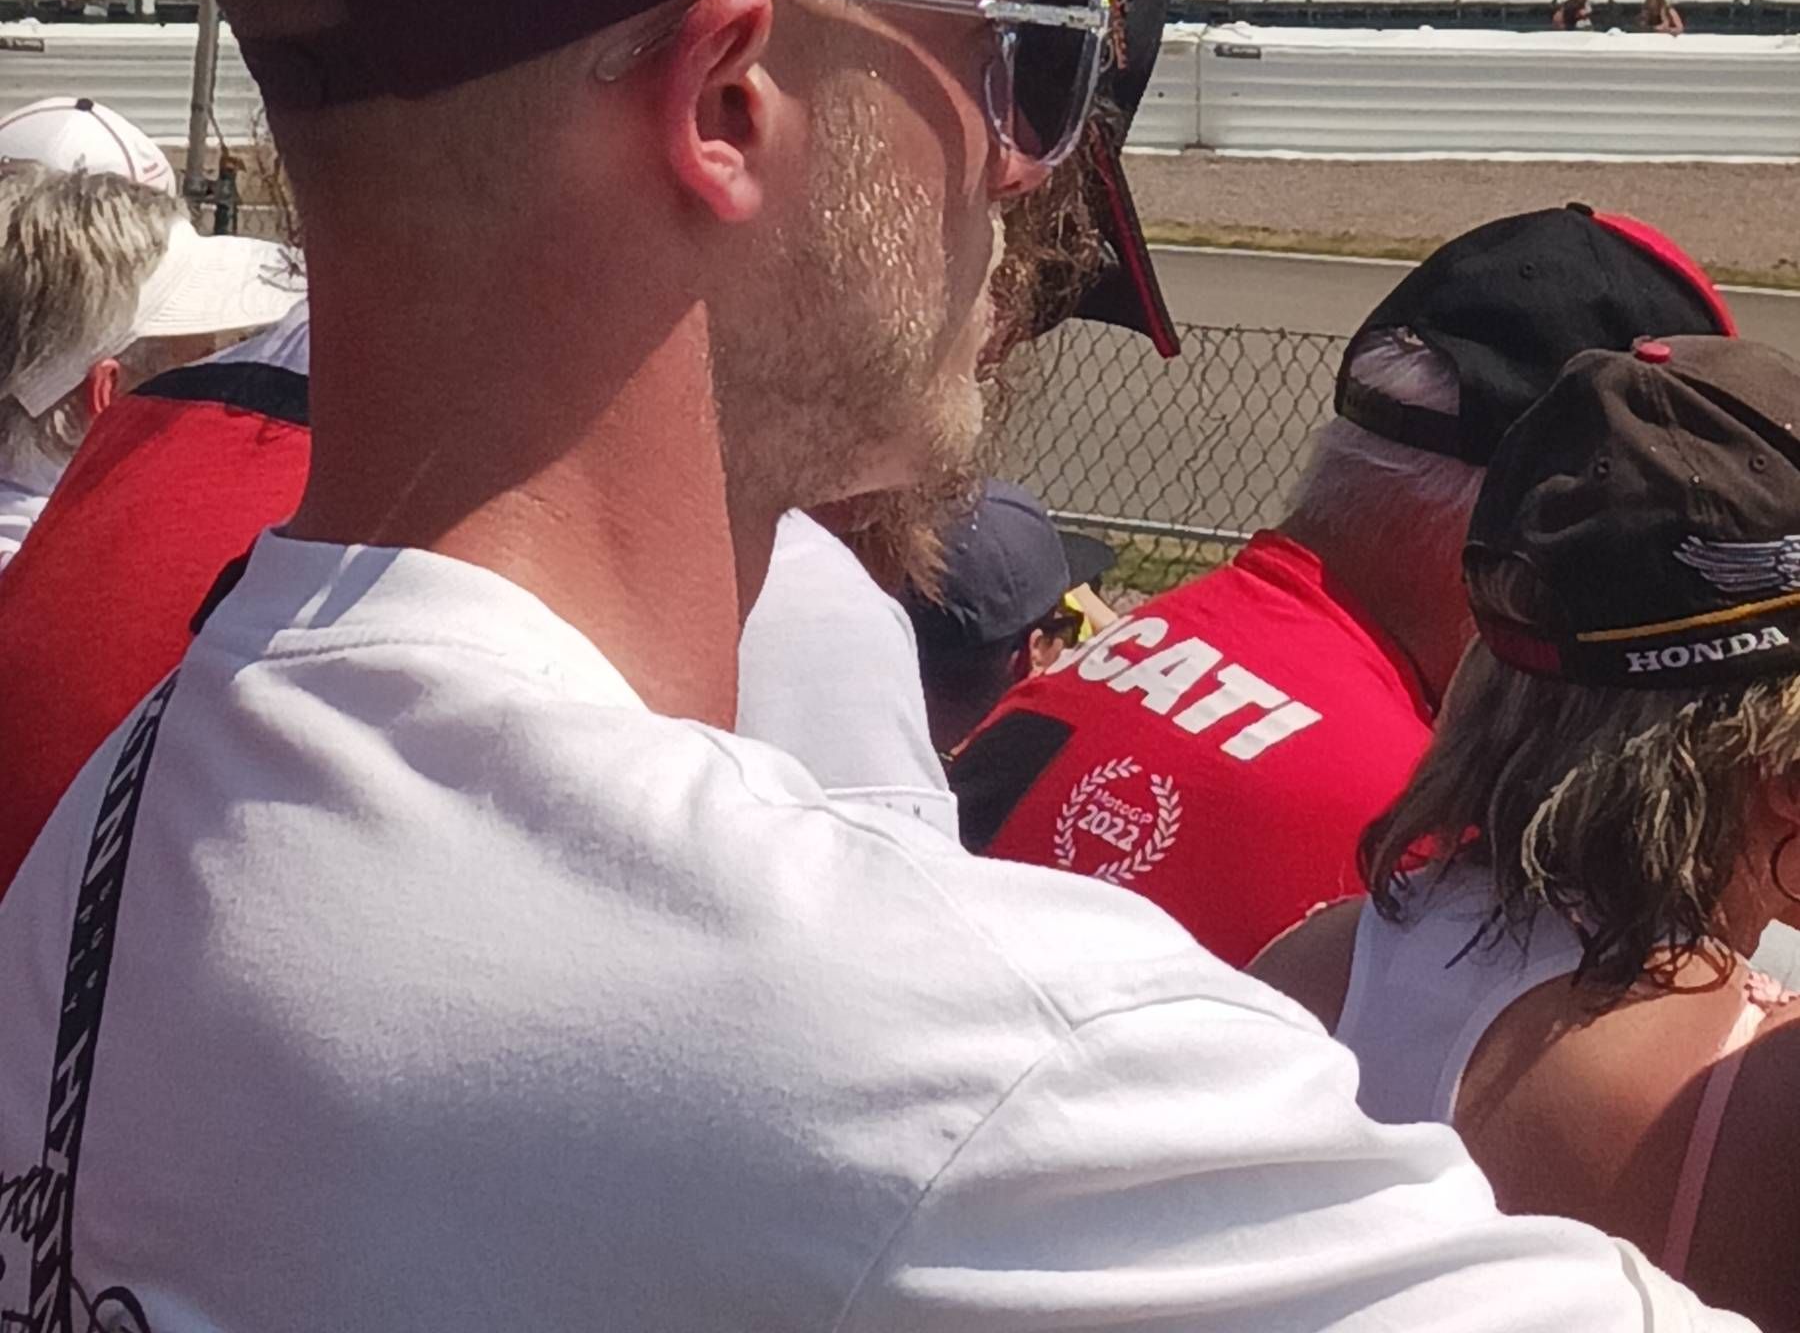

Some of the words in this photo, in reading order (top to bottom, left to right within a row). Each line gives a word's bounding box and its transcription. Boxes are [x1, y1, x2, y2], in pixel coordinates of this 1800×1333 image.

[1625, 626, 1790, 672] HONDA
[1077, 804, 1140, 852] 2022
[1093, 787, 1154, 825] MotoGP
